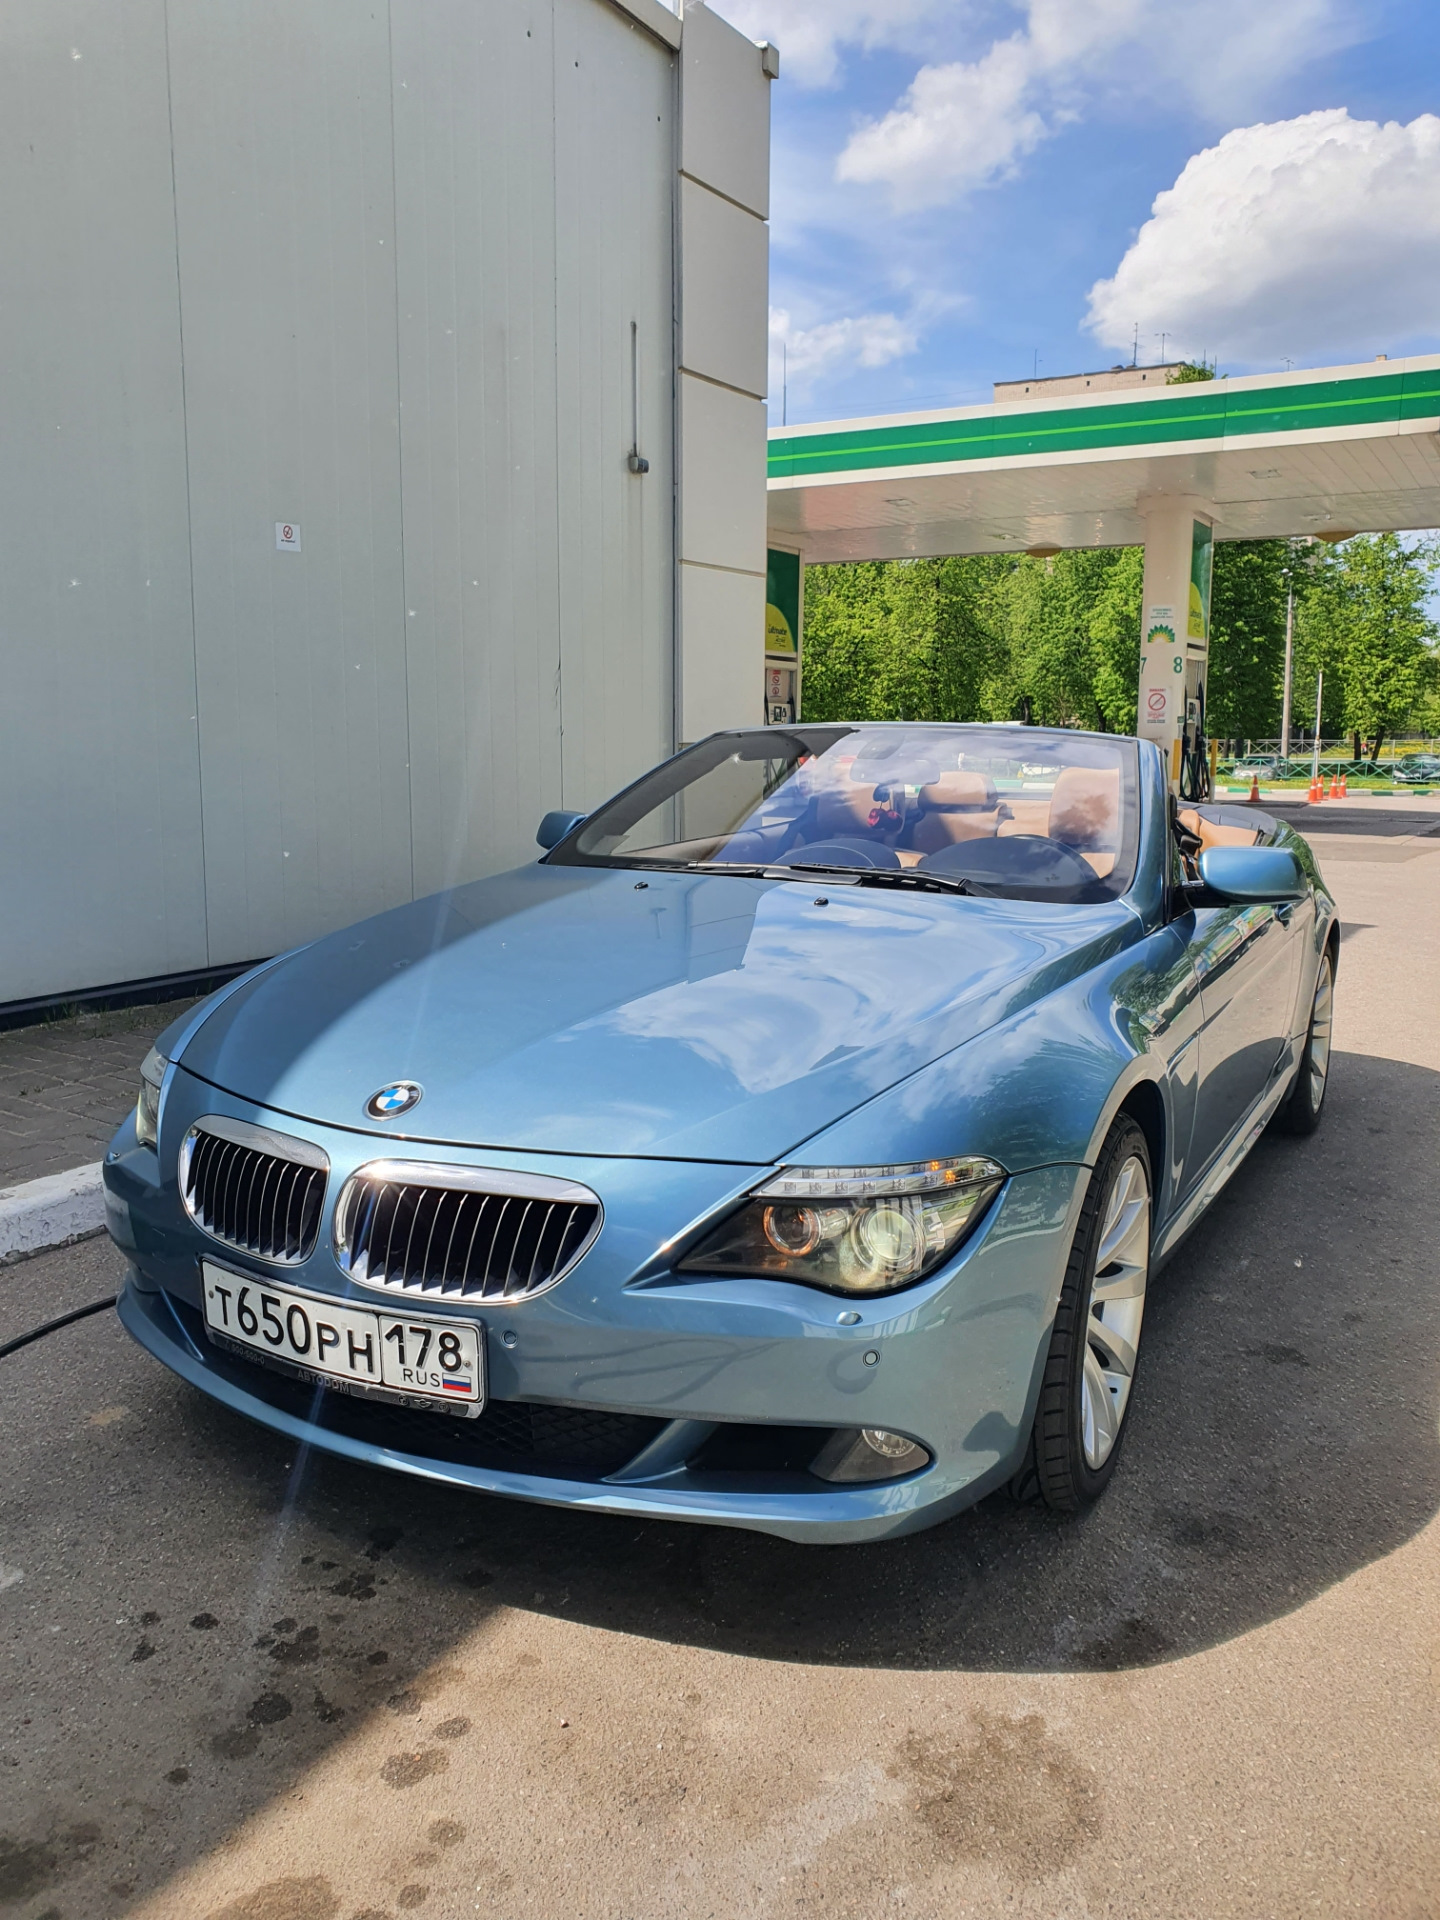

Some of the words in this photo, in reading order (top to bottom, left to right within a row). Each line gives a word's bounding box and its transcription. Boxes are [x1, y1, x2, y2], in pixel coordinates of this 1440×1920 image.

[1141, 656, 1148, 674] 7
[1173, 656, 1183, 673] 8
[214, 1284, 374, 1374] Т650РН
[384, 1323, 463, 1373] 178
[402, 1368, 441, 1388] RUS
